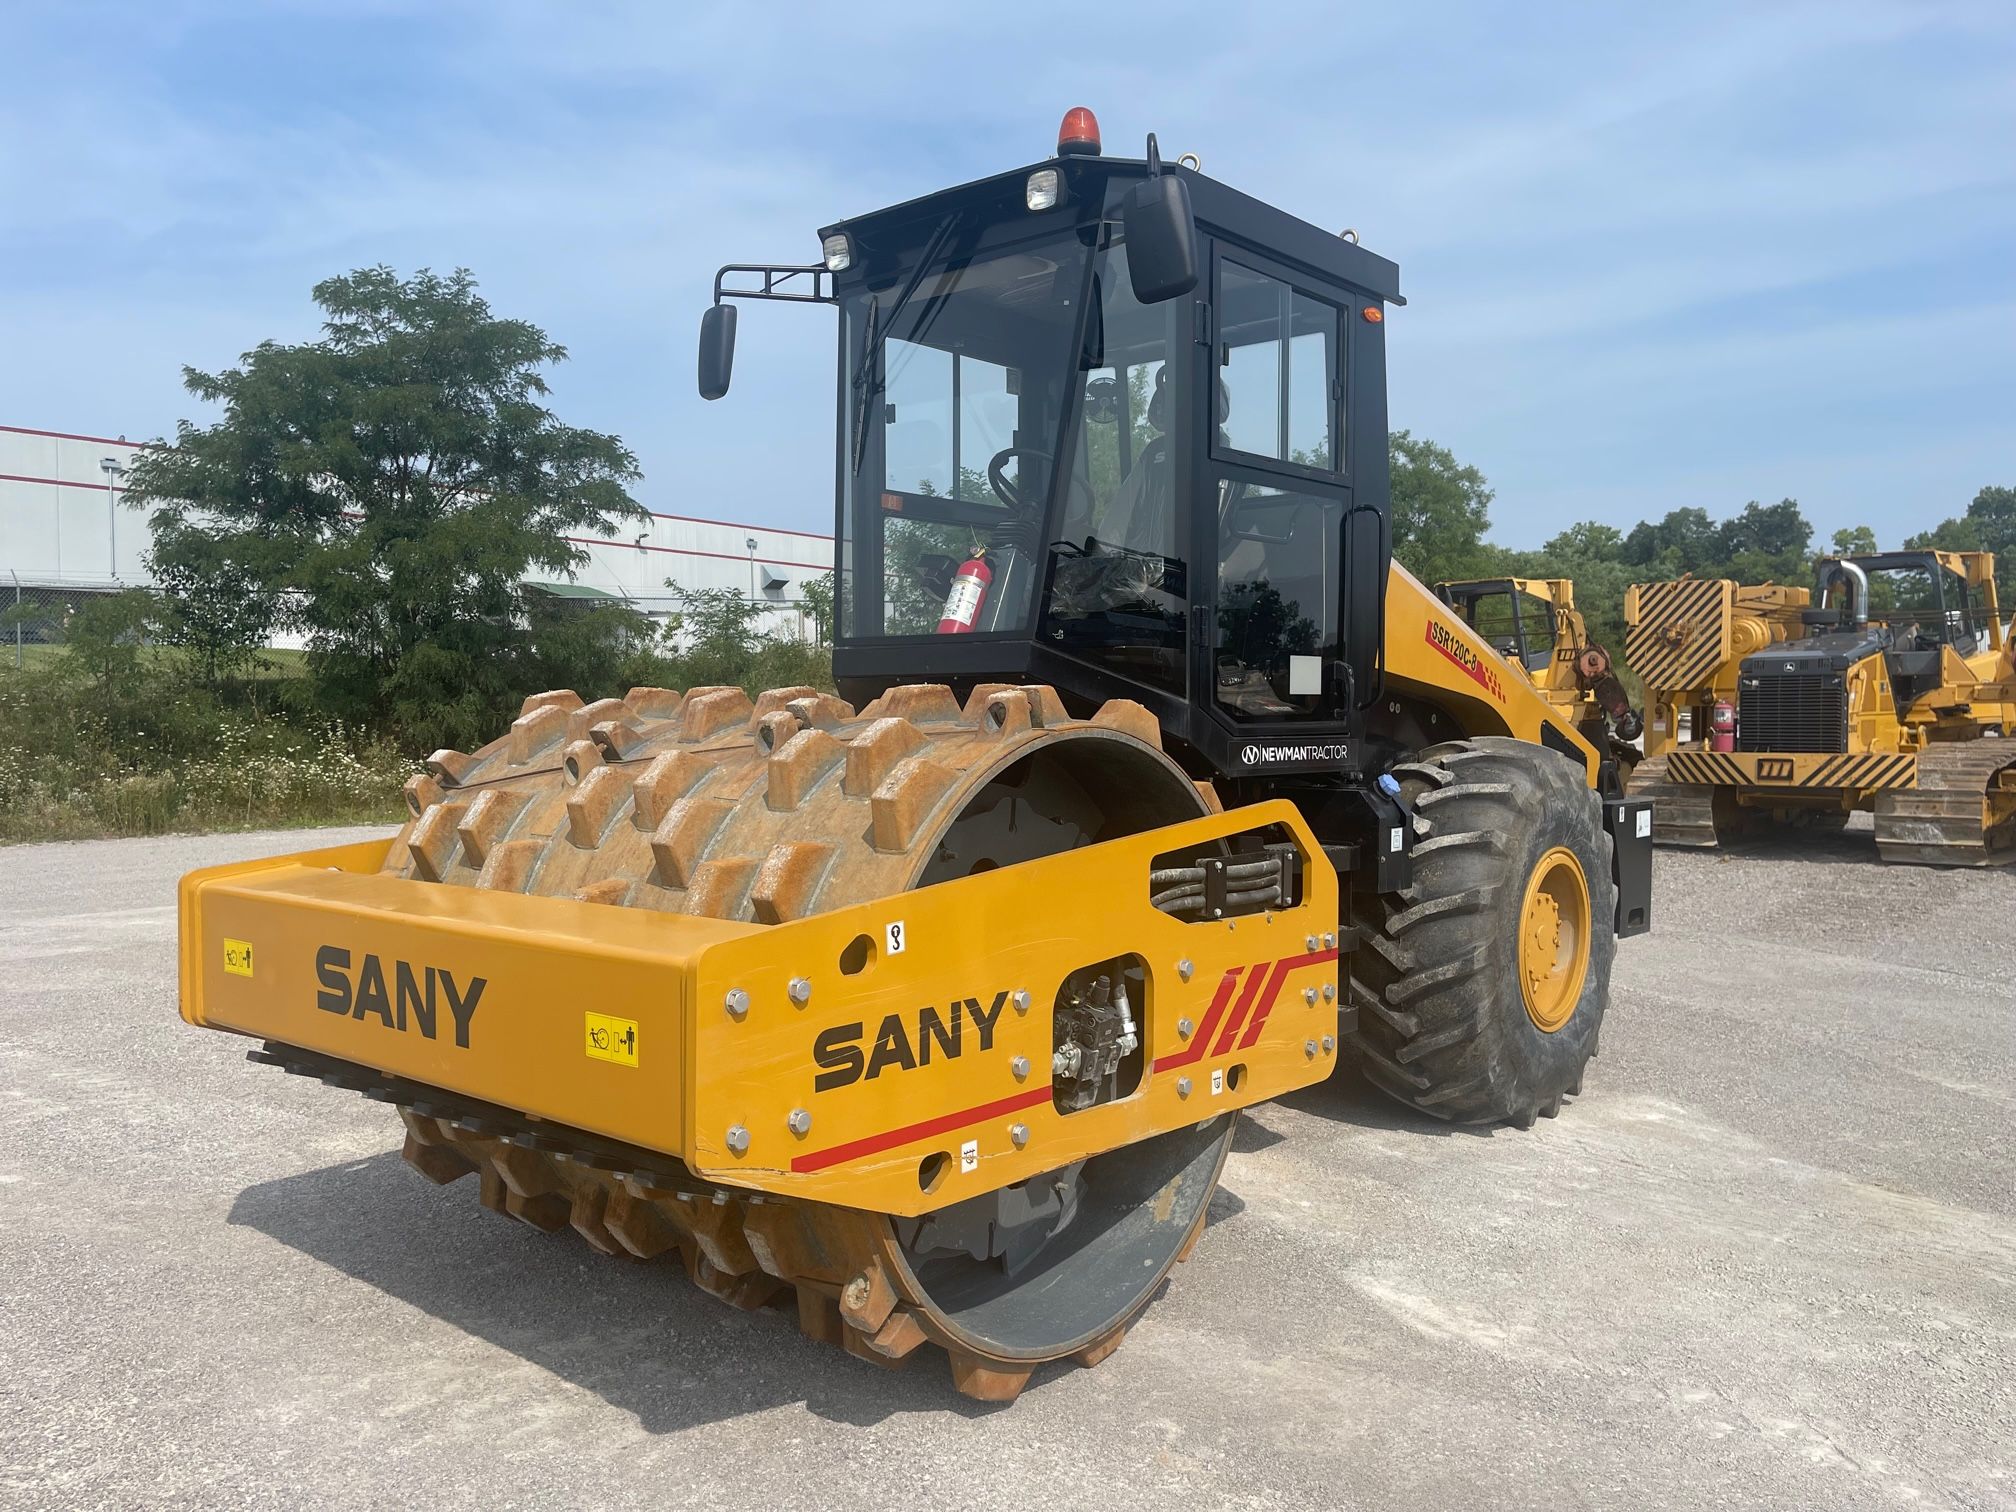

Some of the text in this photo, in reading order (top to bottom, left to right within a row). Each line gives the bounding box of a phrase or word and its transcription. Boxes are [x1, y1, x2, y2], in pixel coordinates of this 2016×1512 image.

[1432, 622, 1477, 671] SSR120C-8
[316, 944, 488, 1049] SANY
[813, 991, 1010, 1093] SANY
